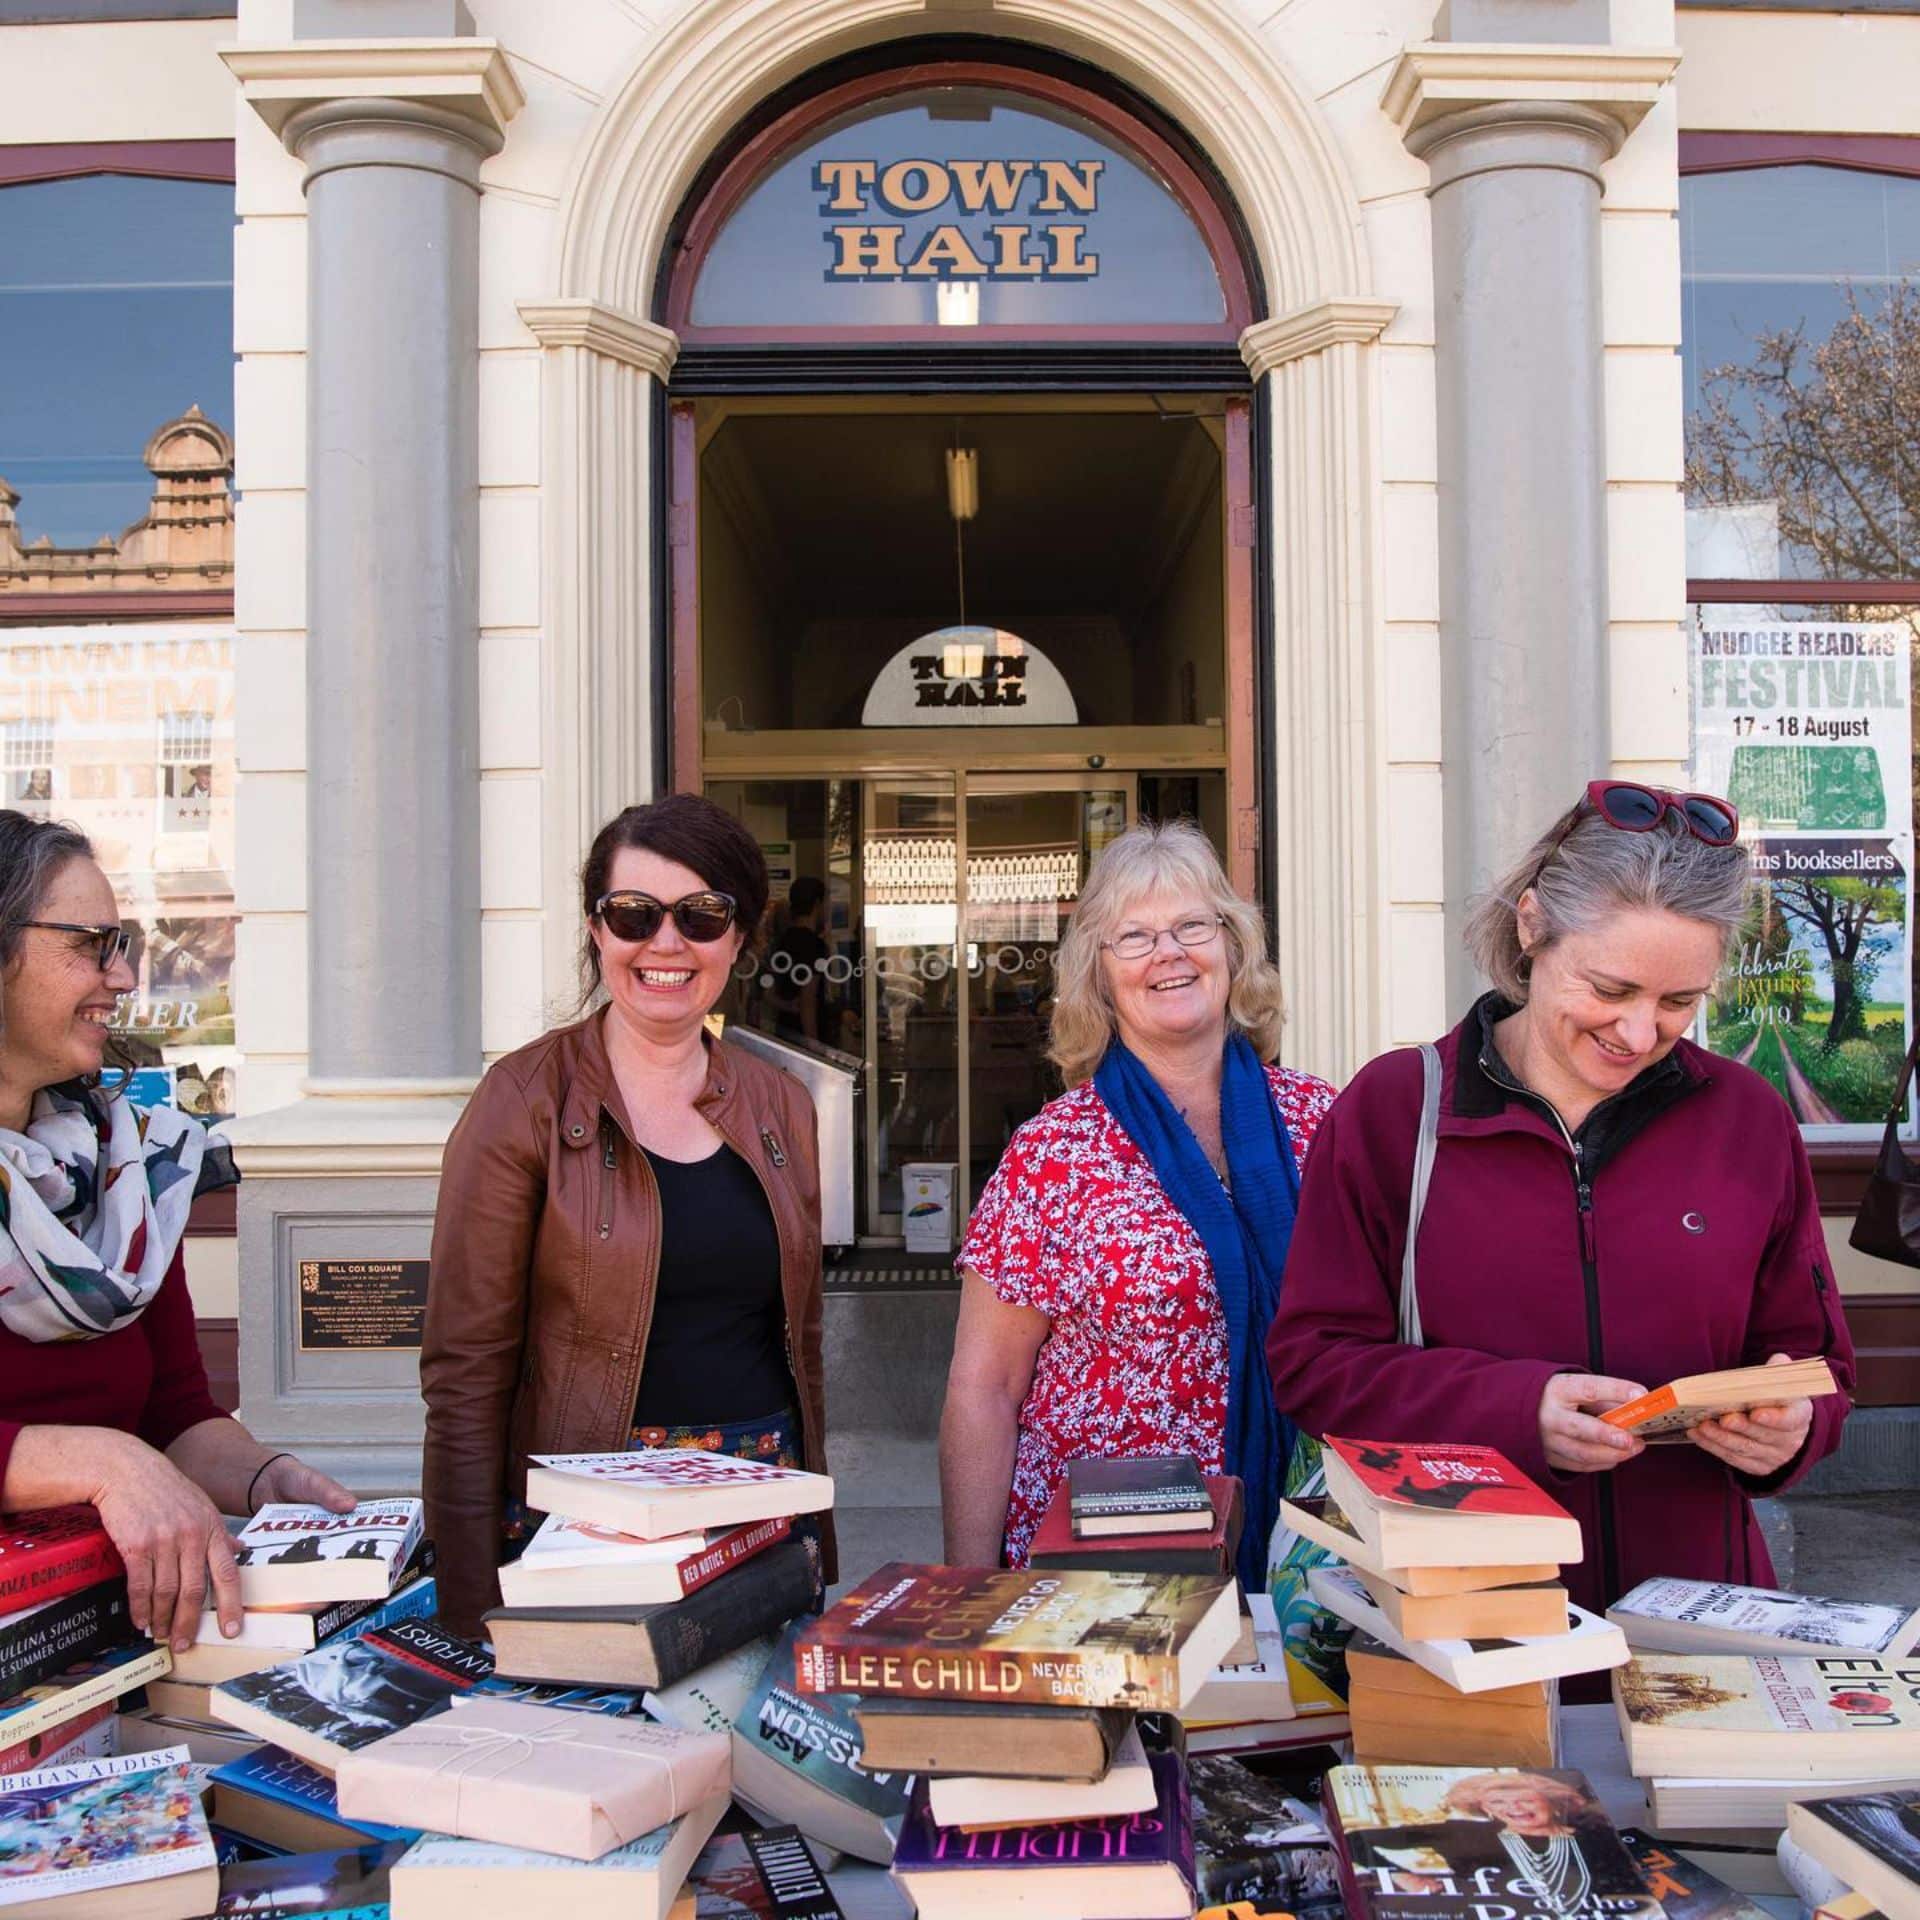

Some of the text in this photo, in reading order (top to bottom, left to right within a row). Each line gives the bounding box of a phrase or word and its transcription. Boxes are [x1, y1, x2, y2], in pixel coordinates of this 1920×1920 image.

[812, 159, 1105, 216] TOWN
[823, 224, 1099, 282] HALL
[1702, 631, 1896, 656] MUDGEE READERS
[915, 682, 1027, 707] HALL
[1702, 659, 1905, 709] FESTIVAL
[1733, 716, 1755, 737] 17
[1777, 716, 1799, 737] 18
[1804, 716, 1870, 741] August
[1752, 849, 1896, 871] ms booksellers
[1728, 939, 1805, 976] elebrate
[1738, 1006, 1792, 1025] 2019
[328, 1265, 403, 1273] BILL COX SQUARE
[682, 1566, 700, 1586] RED
[699, 1549, 725, 1578] NOTICE
[730, 1535, 746, 1558] BILL
[50, 1604, 97, 1639] SIMONS
[894, 1585, 965, 1623] LEE
[986, 1579, 1061, 1635] NEVER GO
[1034, 1590, 1082, 1622] BACK
[10, 1643, 55, 1675] SUMMER
[57, 1622, 98, 1650] GARDEN
[388, 1622, 452, 1661] FURST
[802, 1652, 814, 1678] JACK
[813, 1645, 826, 1692] REACHER
[825, 1651, 835, 1686] NOVEL
[839, 1654, 1023, 1693] LEE CHILD
[1031, 1661, 1086, 1679] NEVER
[1754, 1655, 1788, 1684] FIRST
[1051, 1680, 1098, 1697] BACK
[1, 1769, 79, 1792] BRIAN
[88, 1750, 177, 1778] ALDISS
[1374, 1866, 1550, 1897] Life
[1580, 1893, 1637, 1910] the
